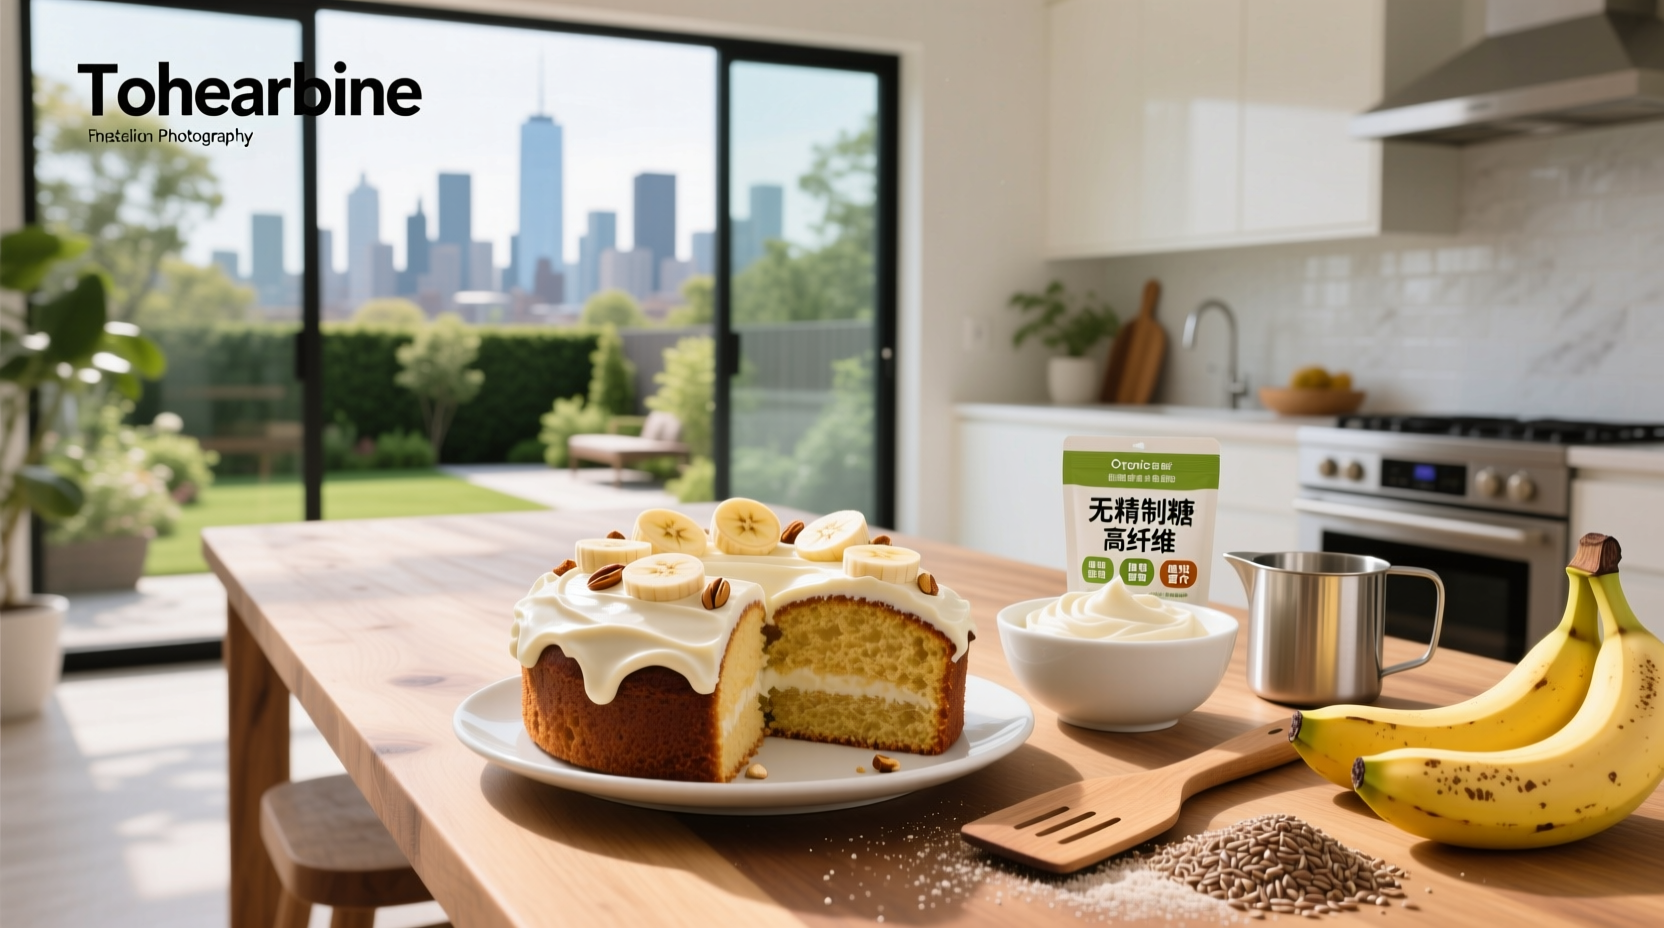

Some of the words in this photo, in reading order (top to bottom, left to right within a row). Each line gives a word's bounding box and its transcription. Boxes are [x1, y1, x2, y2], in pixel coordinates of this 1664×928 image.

[1088, 496, 1195, 527] 无精制糖
[1103, 527, 1176, 554] 高纤维
